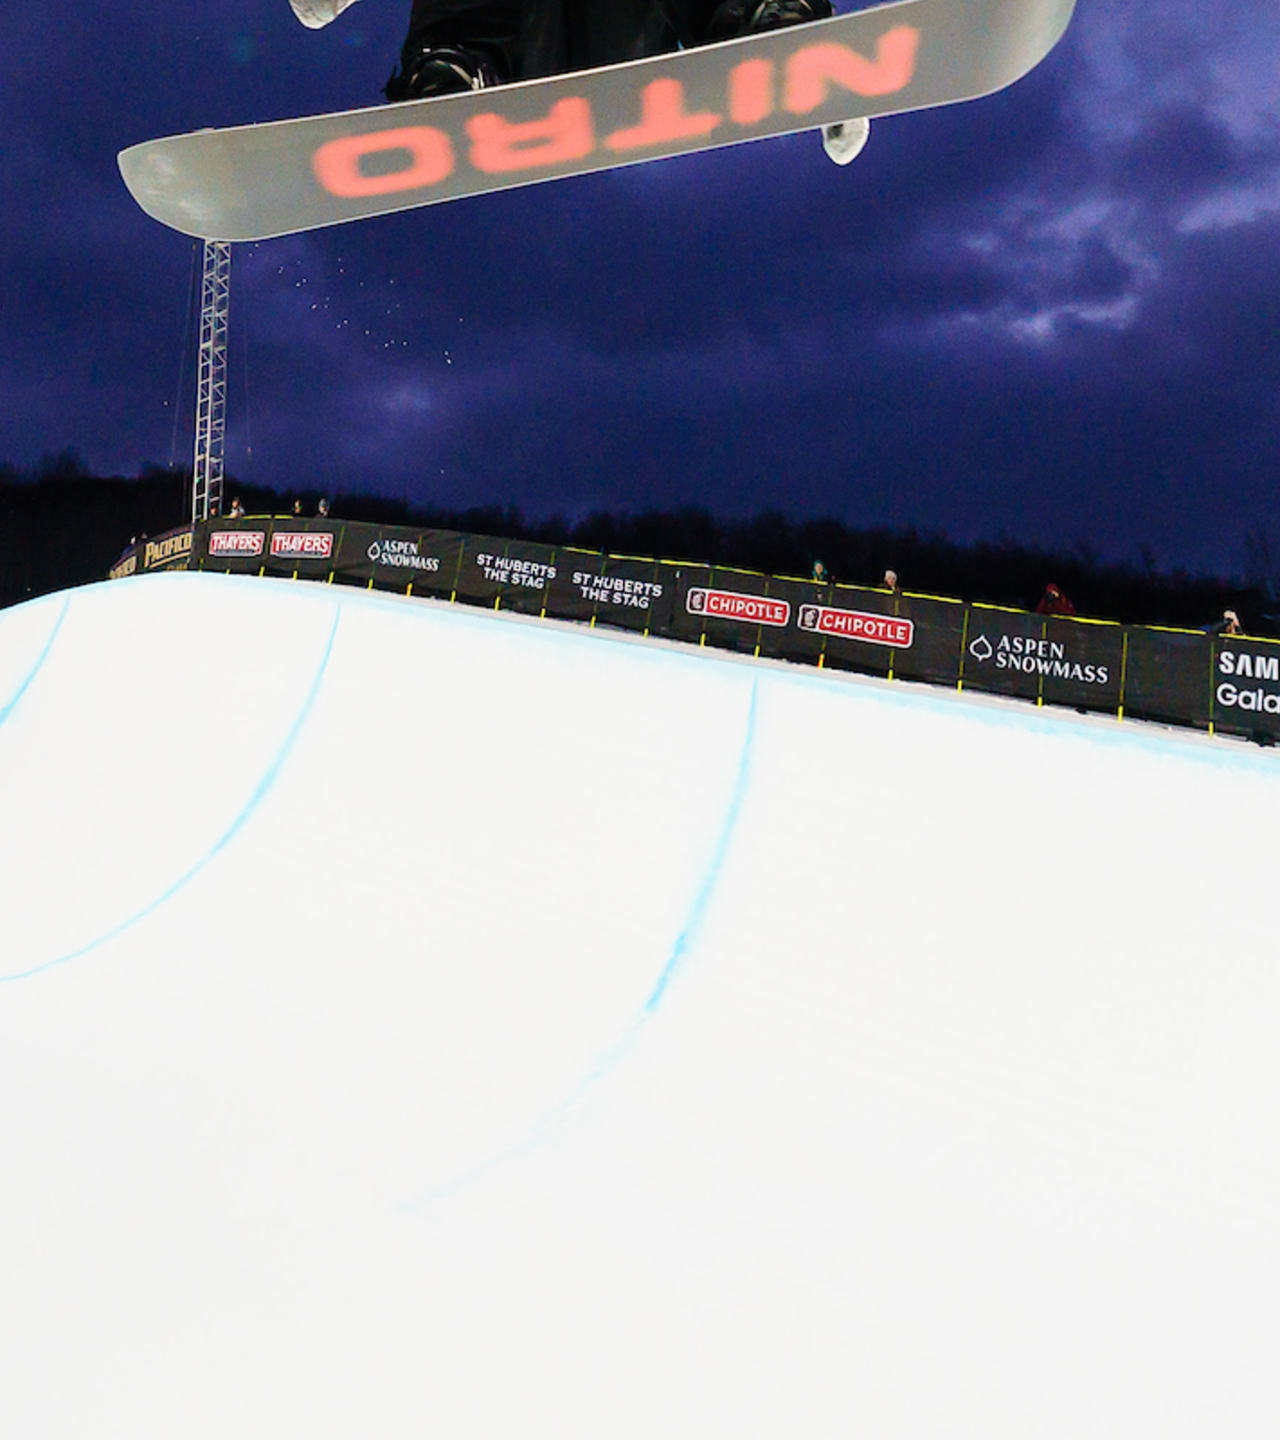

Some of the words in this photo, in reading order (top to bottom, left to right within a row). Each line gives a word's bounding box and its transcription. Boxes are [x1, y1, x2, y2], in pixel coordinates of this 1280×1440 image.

[313, 24, 919, 199] NITRO
[211, 534, 261, 551] THAYERS
[274, 534, 329, 552] THAYERS
[382, 540, 418, 555] ASPEN
[380, 552, 440, 571] SNOWMASS
[476, 553, 493, 567] ST
[494, 557, 556, 578] HUBERTS
[483, 566, 508, 583] THE
[511, 572, 545, 590] STAG
[572, 571, 590, 586] ST
[592, 575, 663, 598] HUBERTS
[580, 586, 608, 604] THE
[610, 592, 650, 609] STAG
[709, 596, 784, 620] CHIPOTLE
[822, 613, 907, 640] CHIPOTLE
[996, 634, 1065, 659] ASPEN
[995, 650, 1109, 684] SNOWMASS
